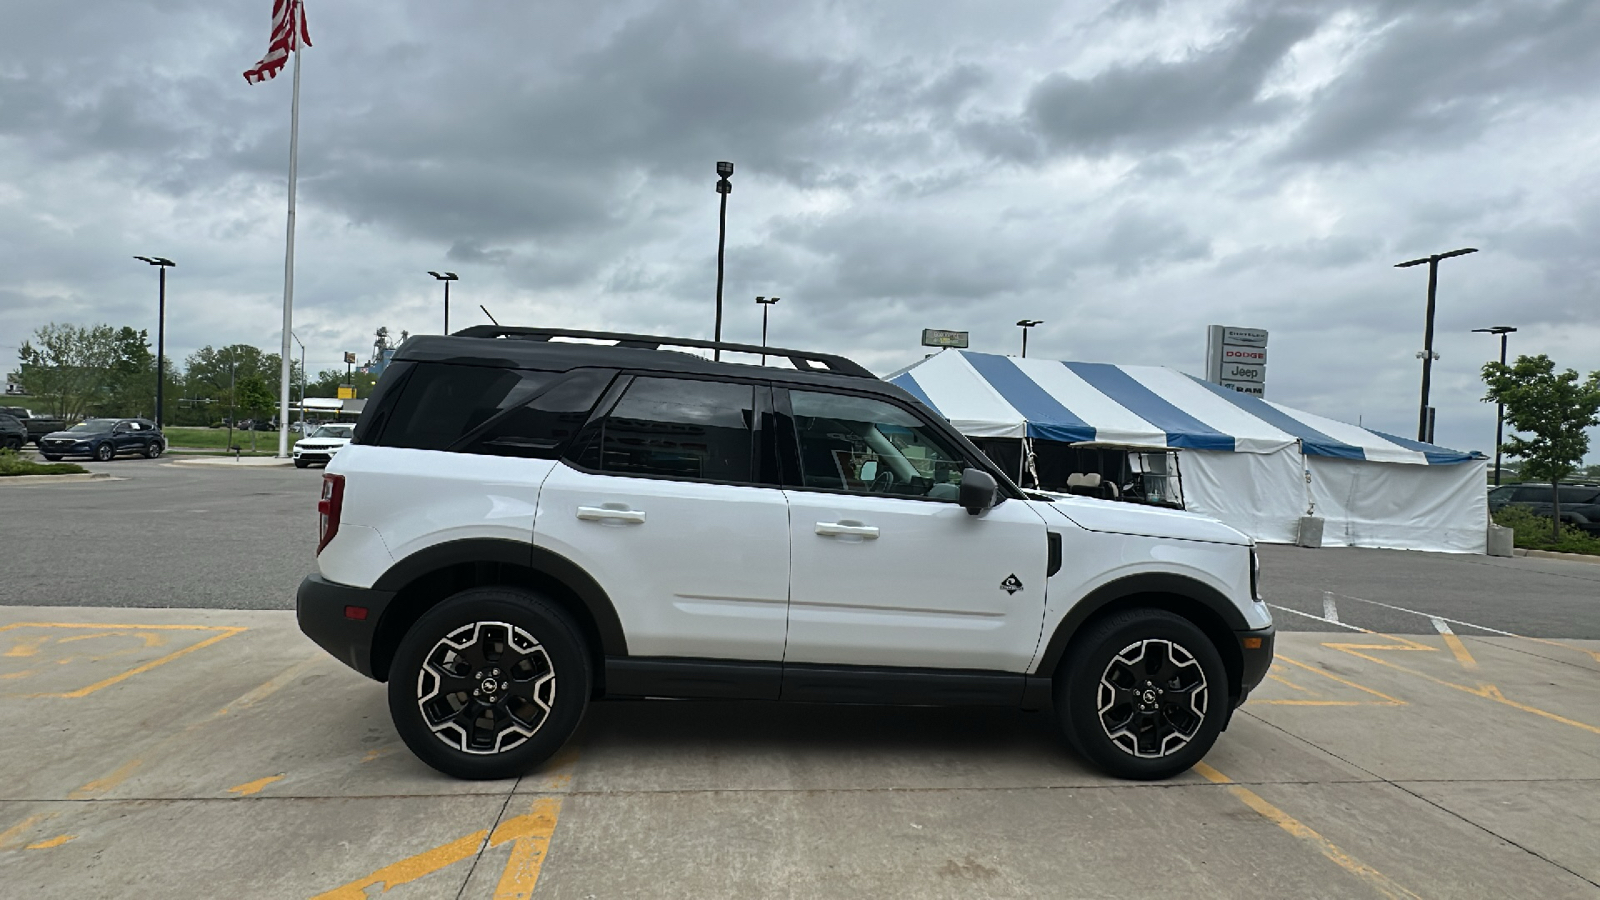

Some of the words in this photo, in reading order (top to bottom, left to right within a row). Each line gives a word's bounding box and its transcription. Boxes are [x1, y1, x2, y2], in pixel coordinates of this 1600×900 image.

[1226, 351, 1264, 359] DODGE
[1231, 366, 1258, 379] Jeep
[1236, 386, 1263, 394] RAM
